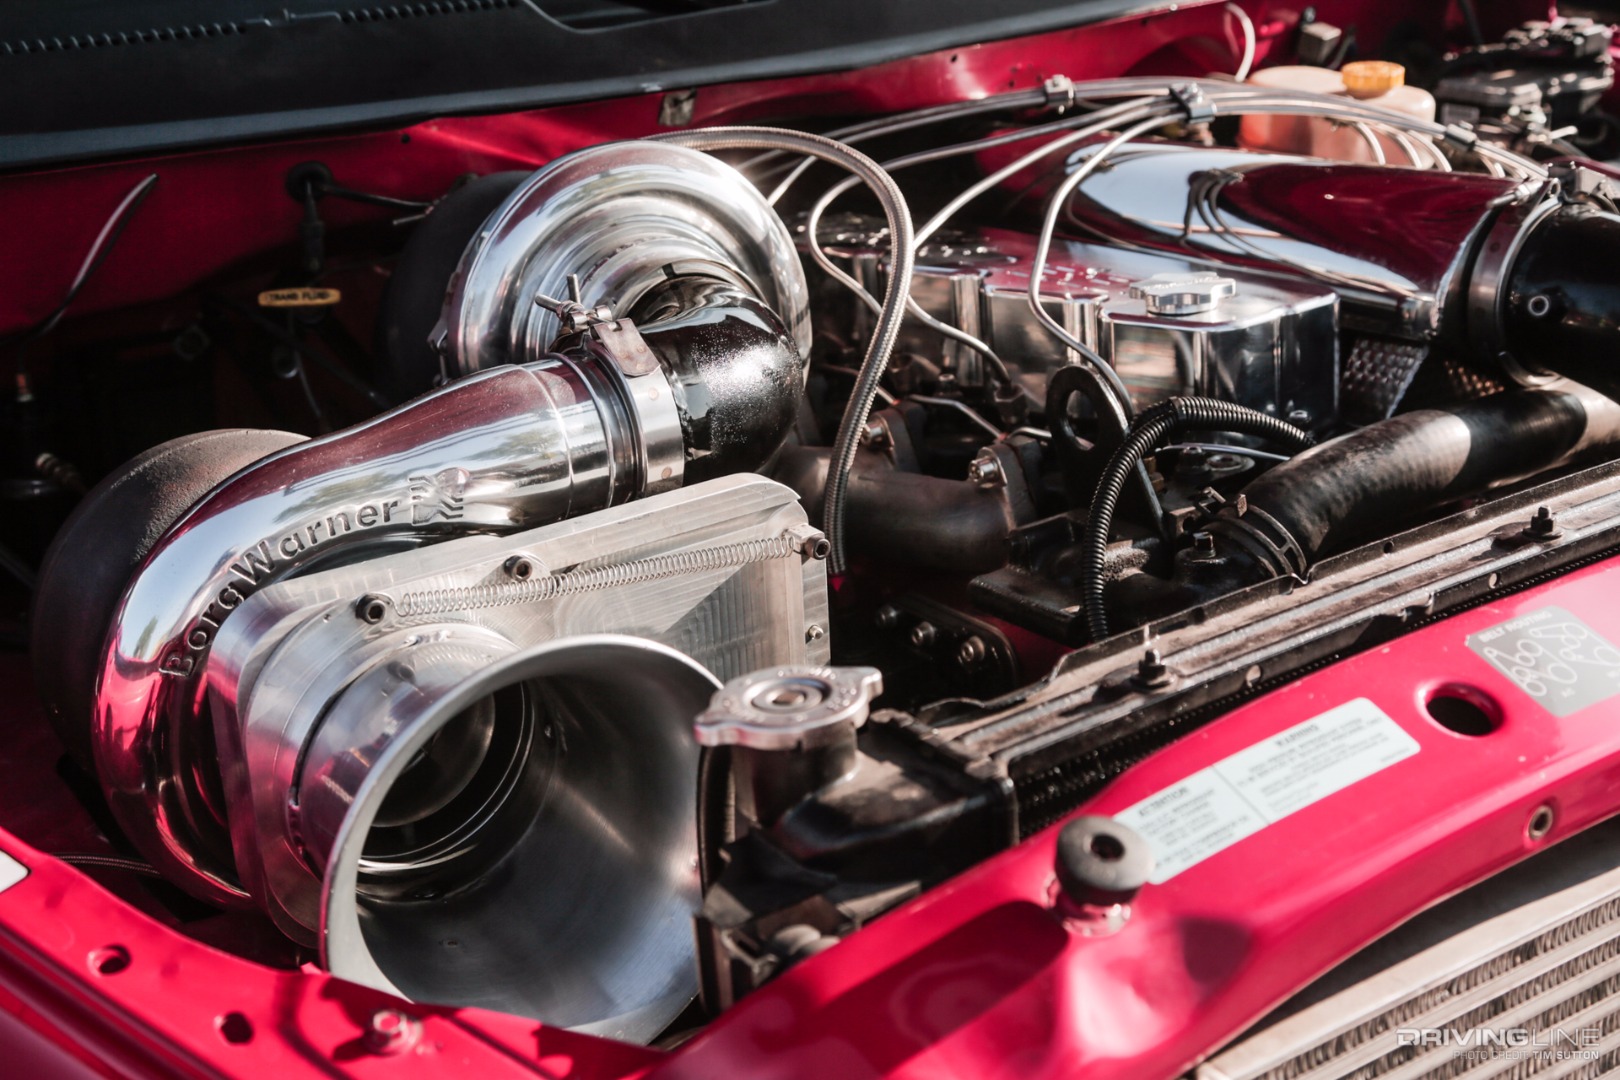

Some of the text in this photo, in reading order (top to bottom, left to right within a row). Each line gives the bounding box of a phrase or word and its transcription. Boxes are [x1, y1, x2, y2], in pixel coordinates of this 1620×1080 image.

[158, 499, 399, 678] BorgWarner
[1478, 611, 1552, 642] BELT ROUTING
